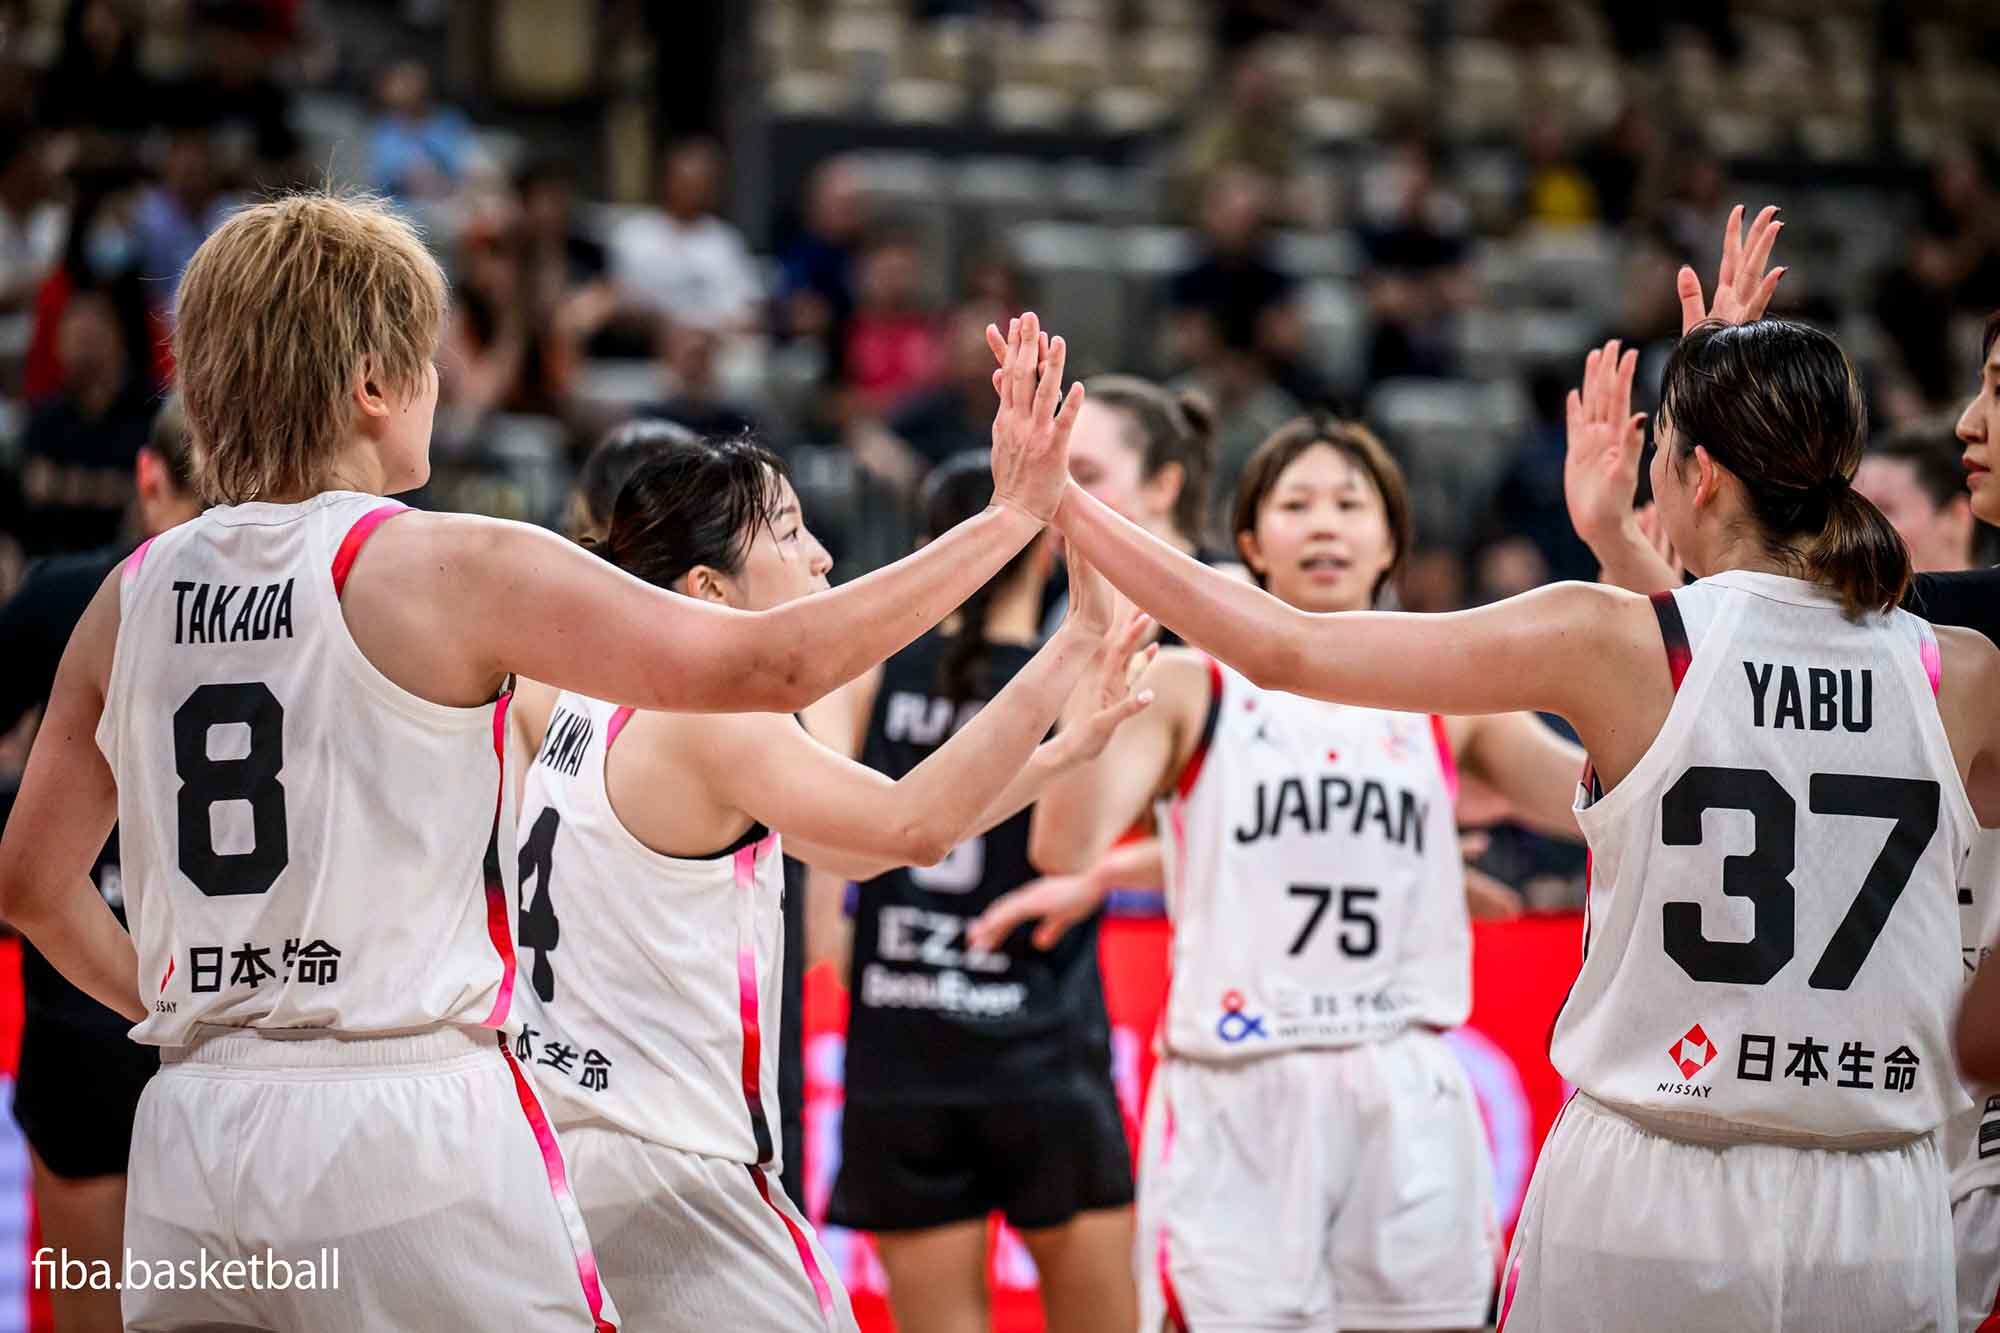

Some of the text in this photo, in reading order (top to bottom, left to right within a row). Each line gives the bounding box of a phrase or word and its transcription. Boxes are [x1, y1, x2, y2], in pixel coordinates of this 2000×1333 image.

[172, 577, 295, 645] TAKADA
[1742, 661, 1873, 733] YABU
[173, 681, 289, 897] 8
[1235, 776, 1428, 853] JAPAN
[1661, 766, 1941, 991] 37
[877, 906, 1011, 974] EZ
[1288, 883, 1379, 958] 75
[1656, 1082, 1712, 1099] NISSAY
[1736, 1033, 1920, 1093] 日本生命
